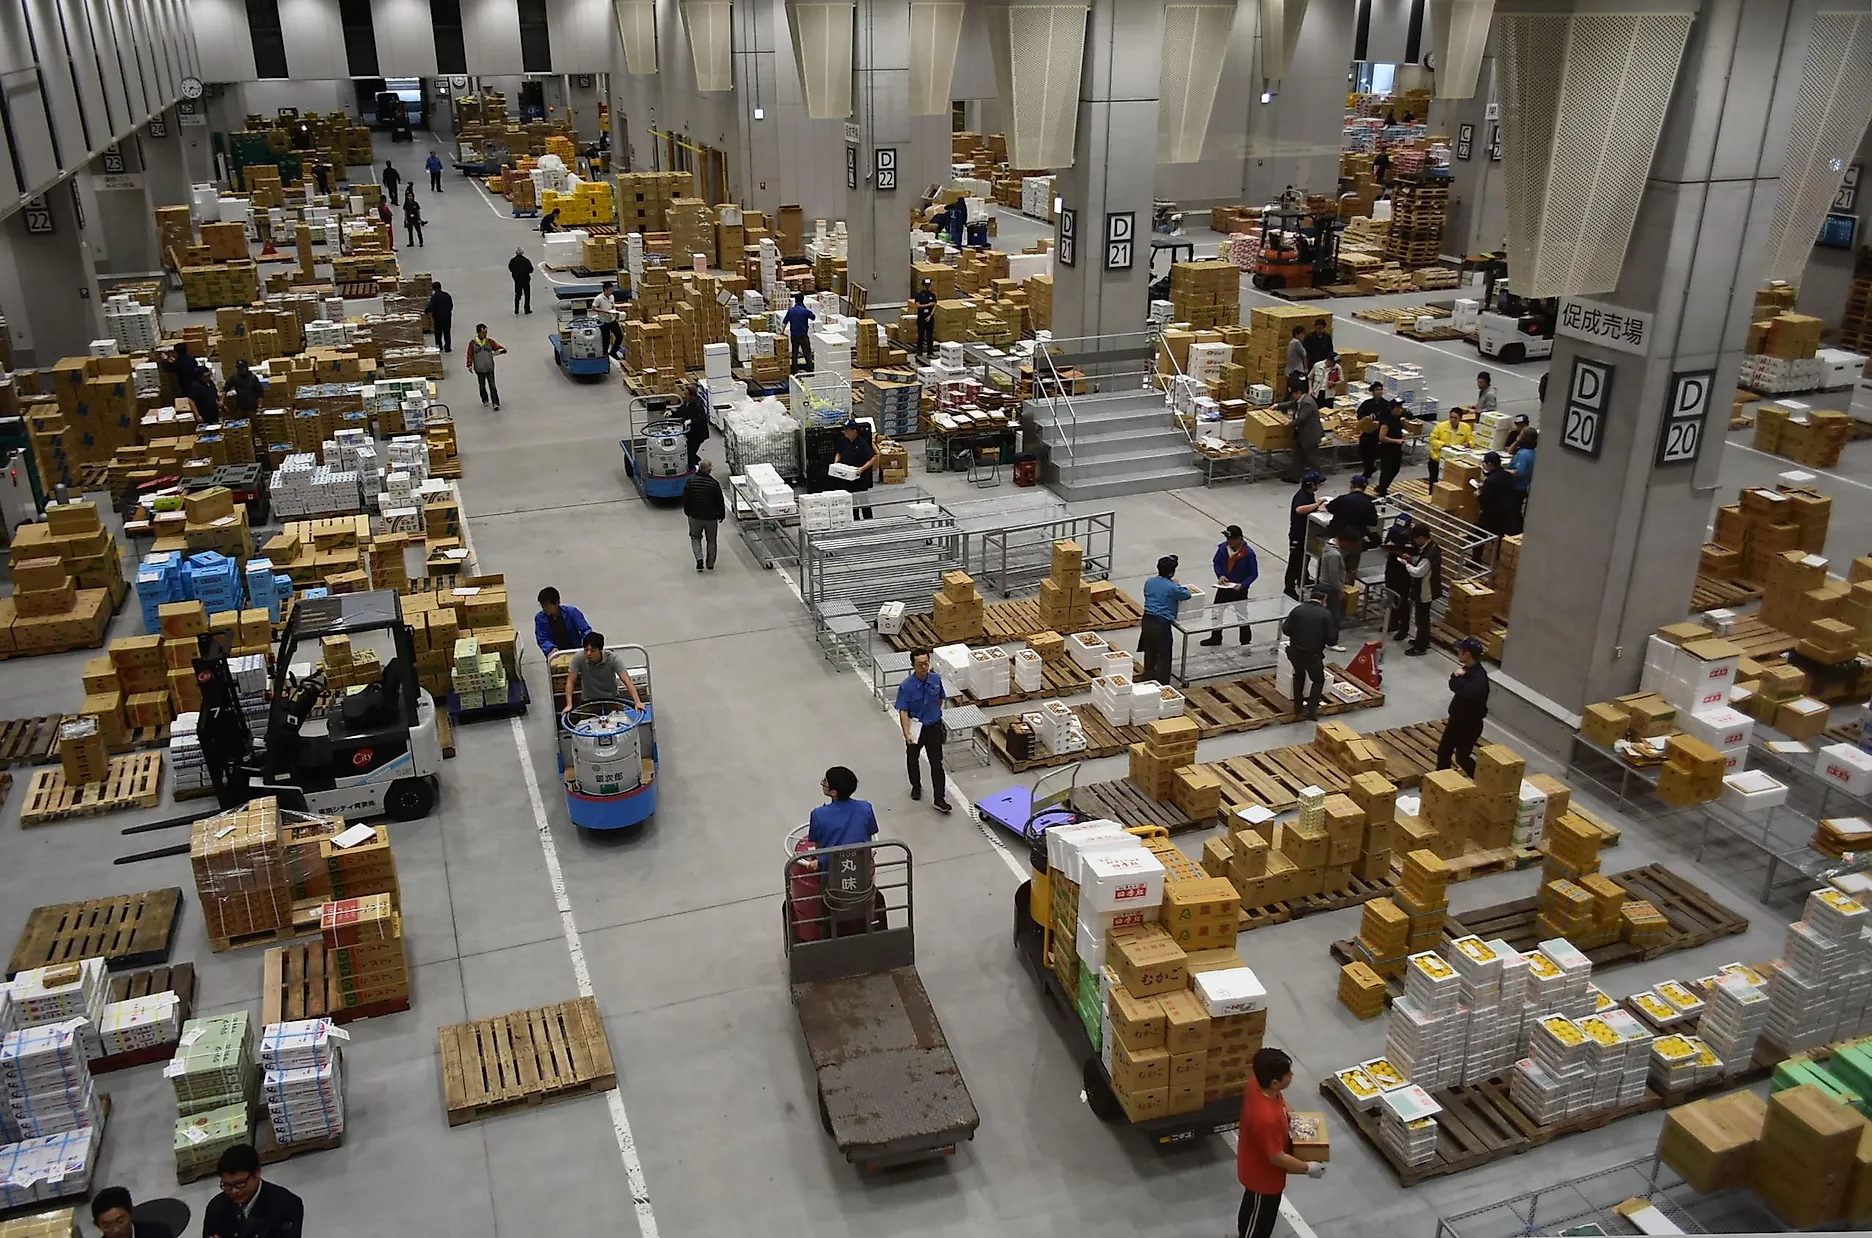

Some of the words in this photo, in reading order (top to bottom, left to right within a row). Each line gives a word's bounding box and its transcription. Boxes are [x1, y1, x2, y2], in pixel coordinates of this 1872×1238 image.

[1463, 128, 1470, 140] C
[107, 158, 121, 170] 23
[881, 152, 892, 167] D
[879, 172, 893, 186] 22
[1844, 169, 1855, 184] C
[1835, 190, 1852, 206] 21
[30, 214, 50, 230] 22
[1064, 213, 1072, 233] D
[1114, 218, 1129, 237] D
[1062, 240, 1071, 260] 21
[1110, 244, 1127, 264] 21
[1562, 302, 1644, 346] 促成売場
[1577, 367, 1600, 400] D
[1678, 380, 1703, 412] D
[1566, 410, 1595, 446] 20
[1666, 423, 1697, 456] 20
[210, 707, 221, 719] 7
[353, 752, 373, 765] City
[1141, 966, 1184, 986] むかご
